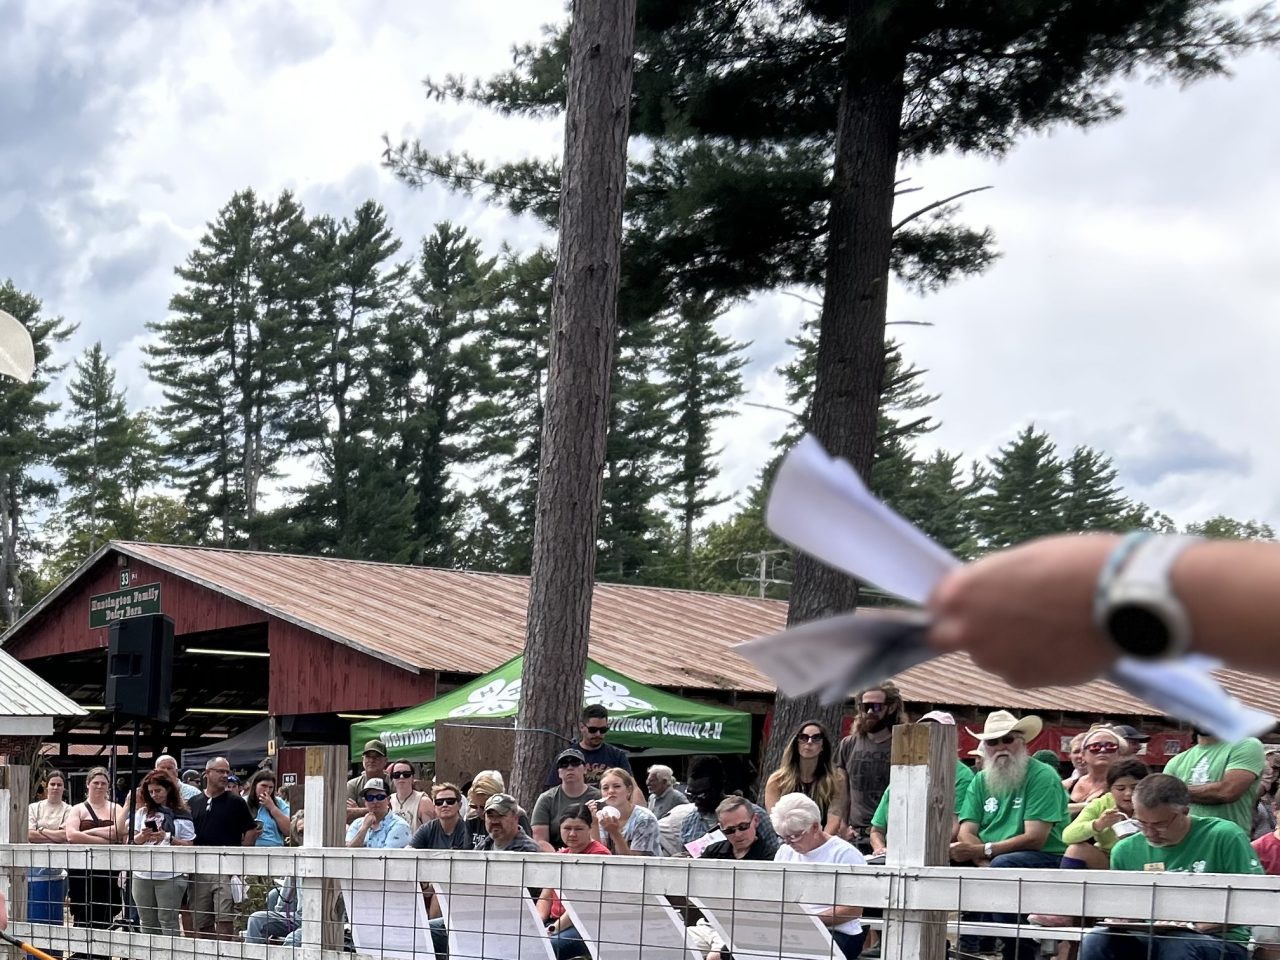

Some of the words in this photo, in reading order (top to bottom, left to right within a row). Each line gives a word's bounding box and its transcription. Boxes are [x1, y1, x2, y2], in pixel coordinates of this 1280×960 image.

[133, 588, 159, 602] Family
[607, 714, 660, 735] errimack
[661, 716, 700, 739] County
[701, 722, 723, 740] 4-H
